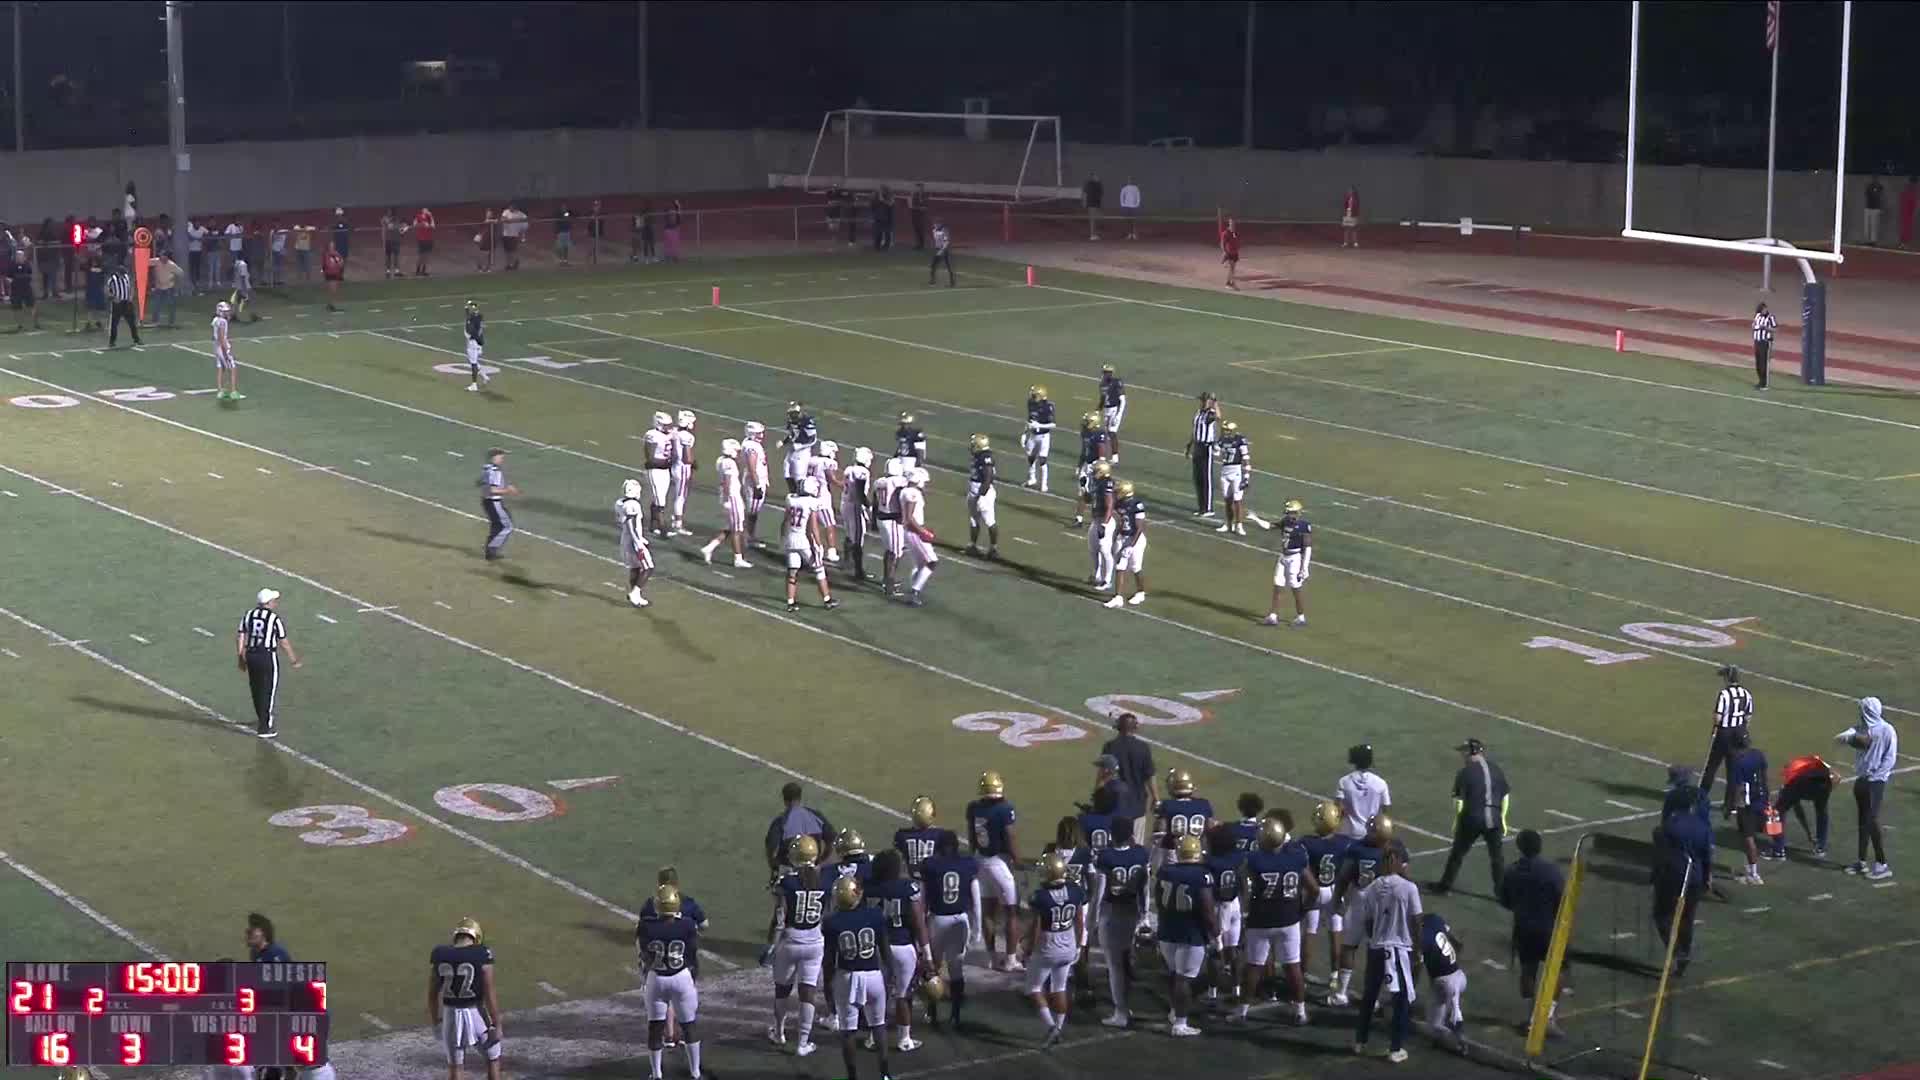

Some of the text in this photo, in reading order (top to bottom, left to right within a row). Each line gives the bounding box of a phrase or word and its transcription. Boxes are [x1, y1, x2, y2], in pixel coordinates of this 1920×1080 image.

[252, 619, 265, 637] R
[1733, 698, 1745, 716] L
[795, 890, 825, 924] 15
[438, 962, 476, 999] 22
